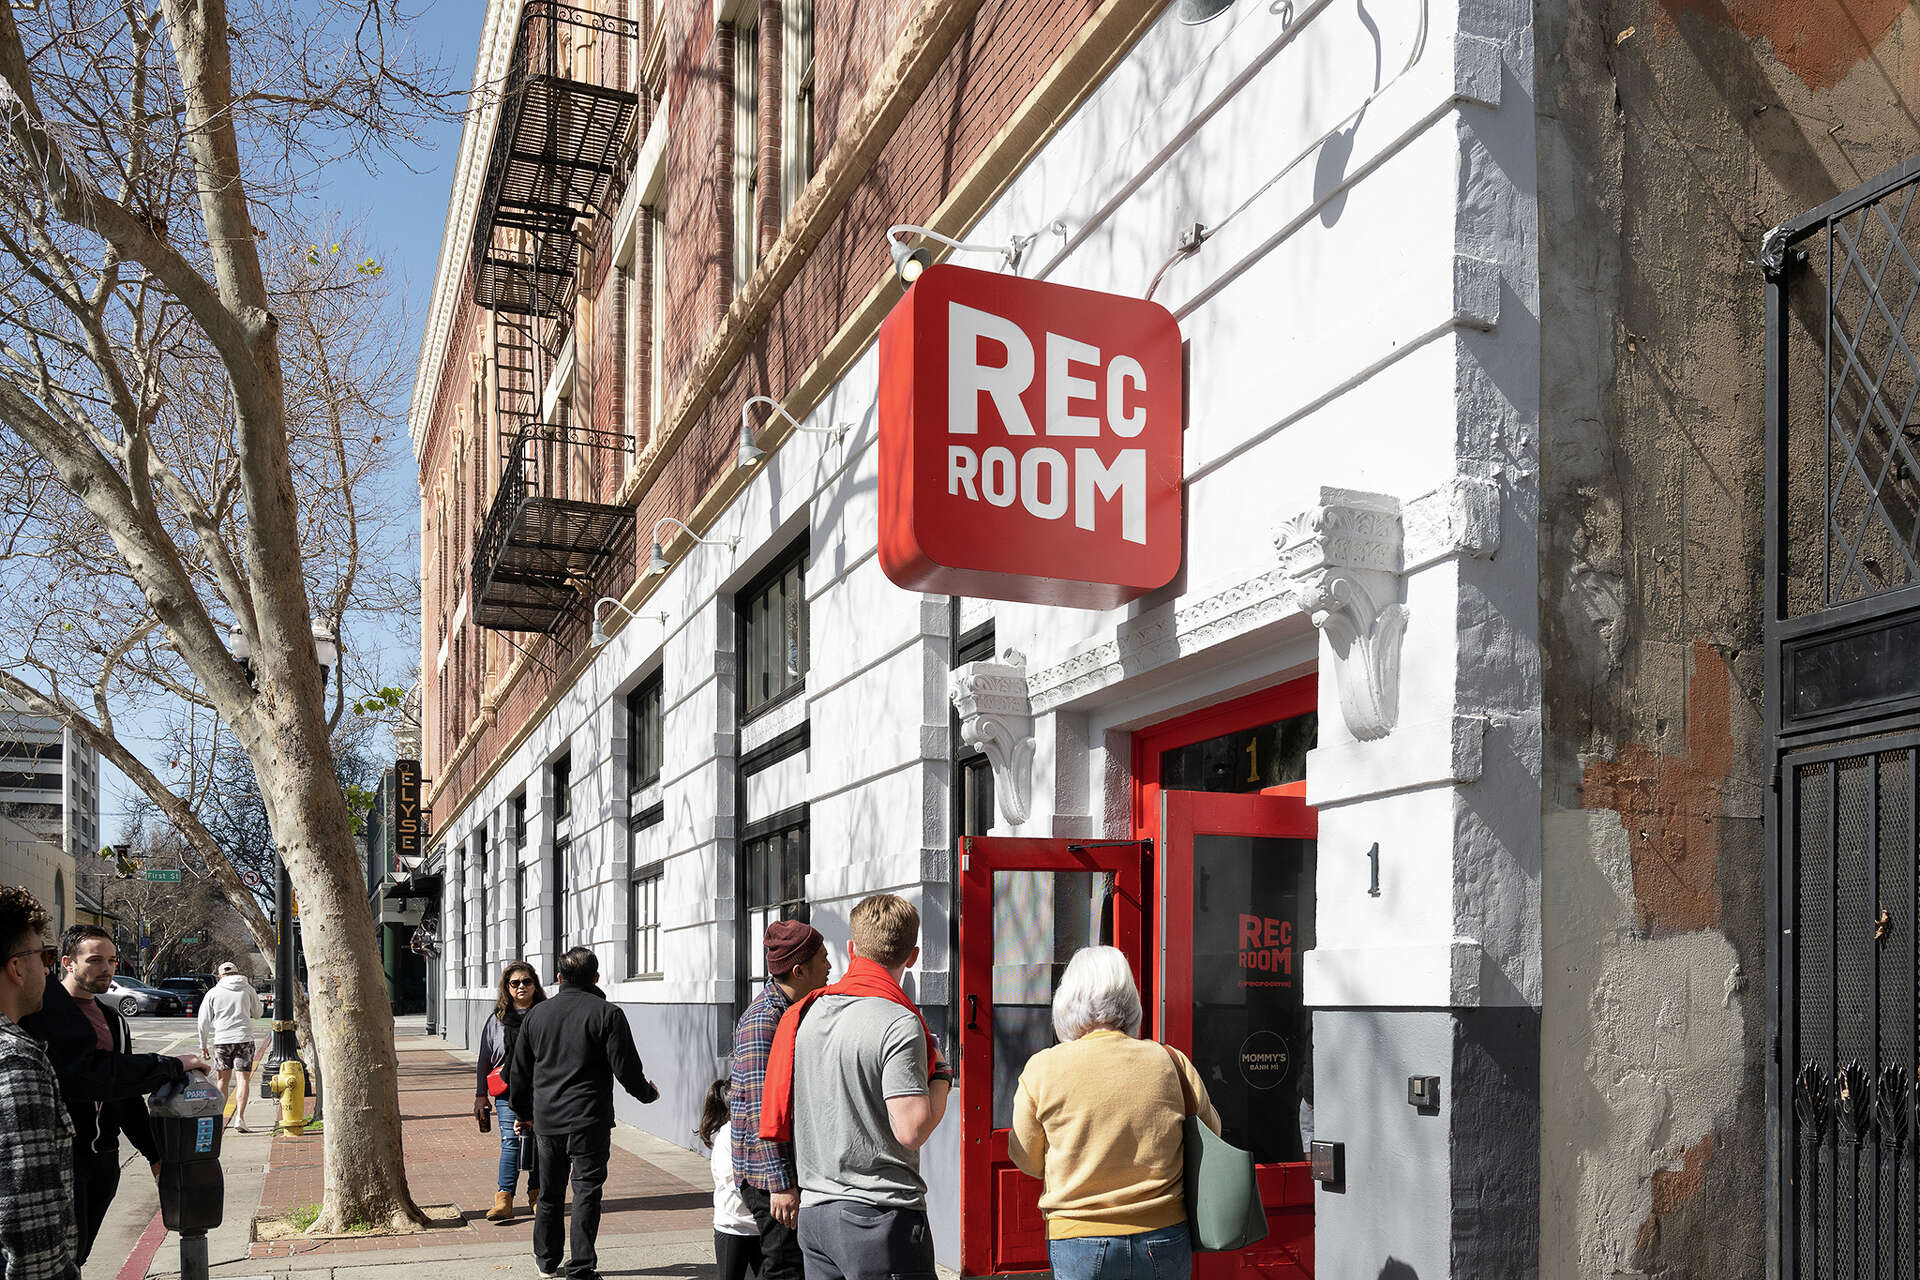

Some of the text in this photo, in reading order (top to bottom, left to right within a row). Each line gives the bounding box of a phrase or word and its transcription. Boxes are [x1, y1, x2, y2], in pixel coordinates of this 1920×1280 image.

[948, 300, 1147, 438] REC
[948, 445, 1147, 545] ROOM
[1246, 736, 1260, 782] 1
[399, 772, 417, 849] ELYSE
[147, 872, 179, 880] First St
[1367, 842, 1380, 898] 1
[1239, 913, 1292, 950] REC
[1238, 947, 1292, 975] ROOM
[1241, 1053, 1286, 1062] MOMMY'S
